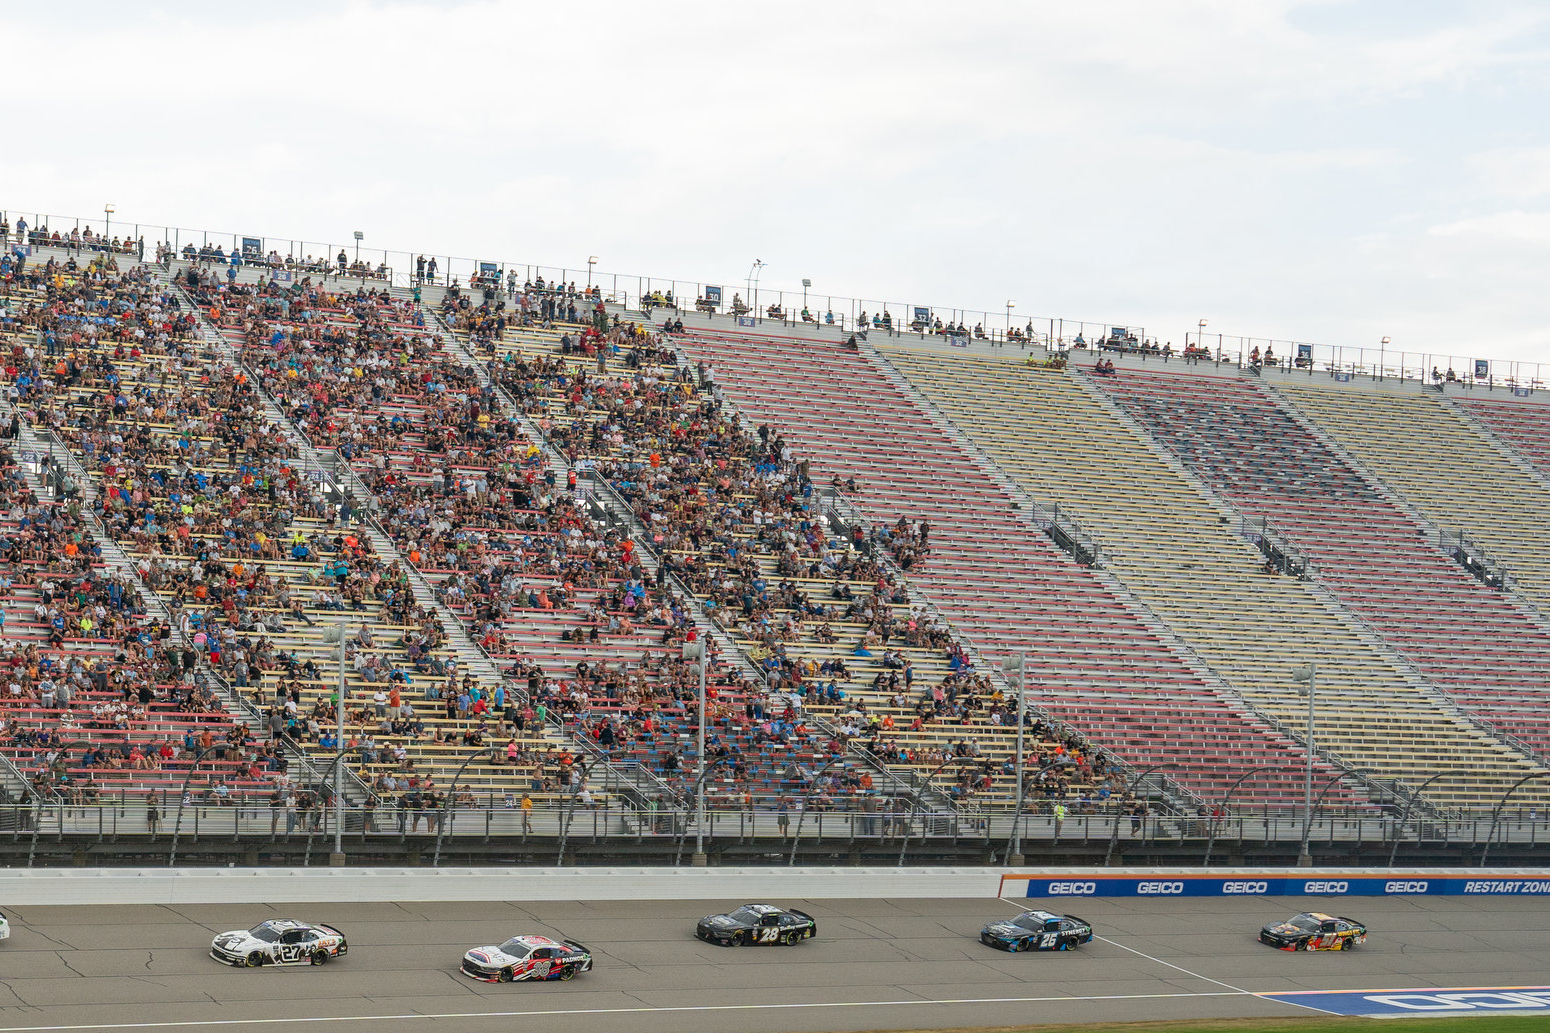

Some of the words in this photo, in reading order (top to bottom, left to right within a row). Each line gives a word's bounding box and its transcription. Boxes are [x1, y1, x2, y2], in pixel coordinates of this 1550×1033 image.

[246, 245, 257, 254] 26
[1048, 881, 1096, 895] GEICO
[1137, 881, 1184, 895] GEICO
[1222, 881, 1268, 894] GEICO
[1304, 881, 1349, 894] GEICO
[1384, 881, 1429, 894] GEICO
[1464, 881, 1521, 893] RESTART
[760, 927, 779, 942] 28
[1041, 933, 1058, 948] 26
[282, 945, 301, 959] 27
